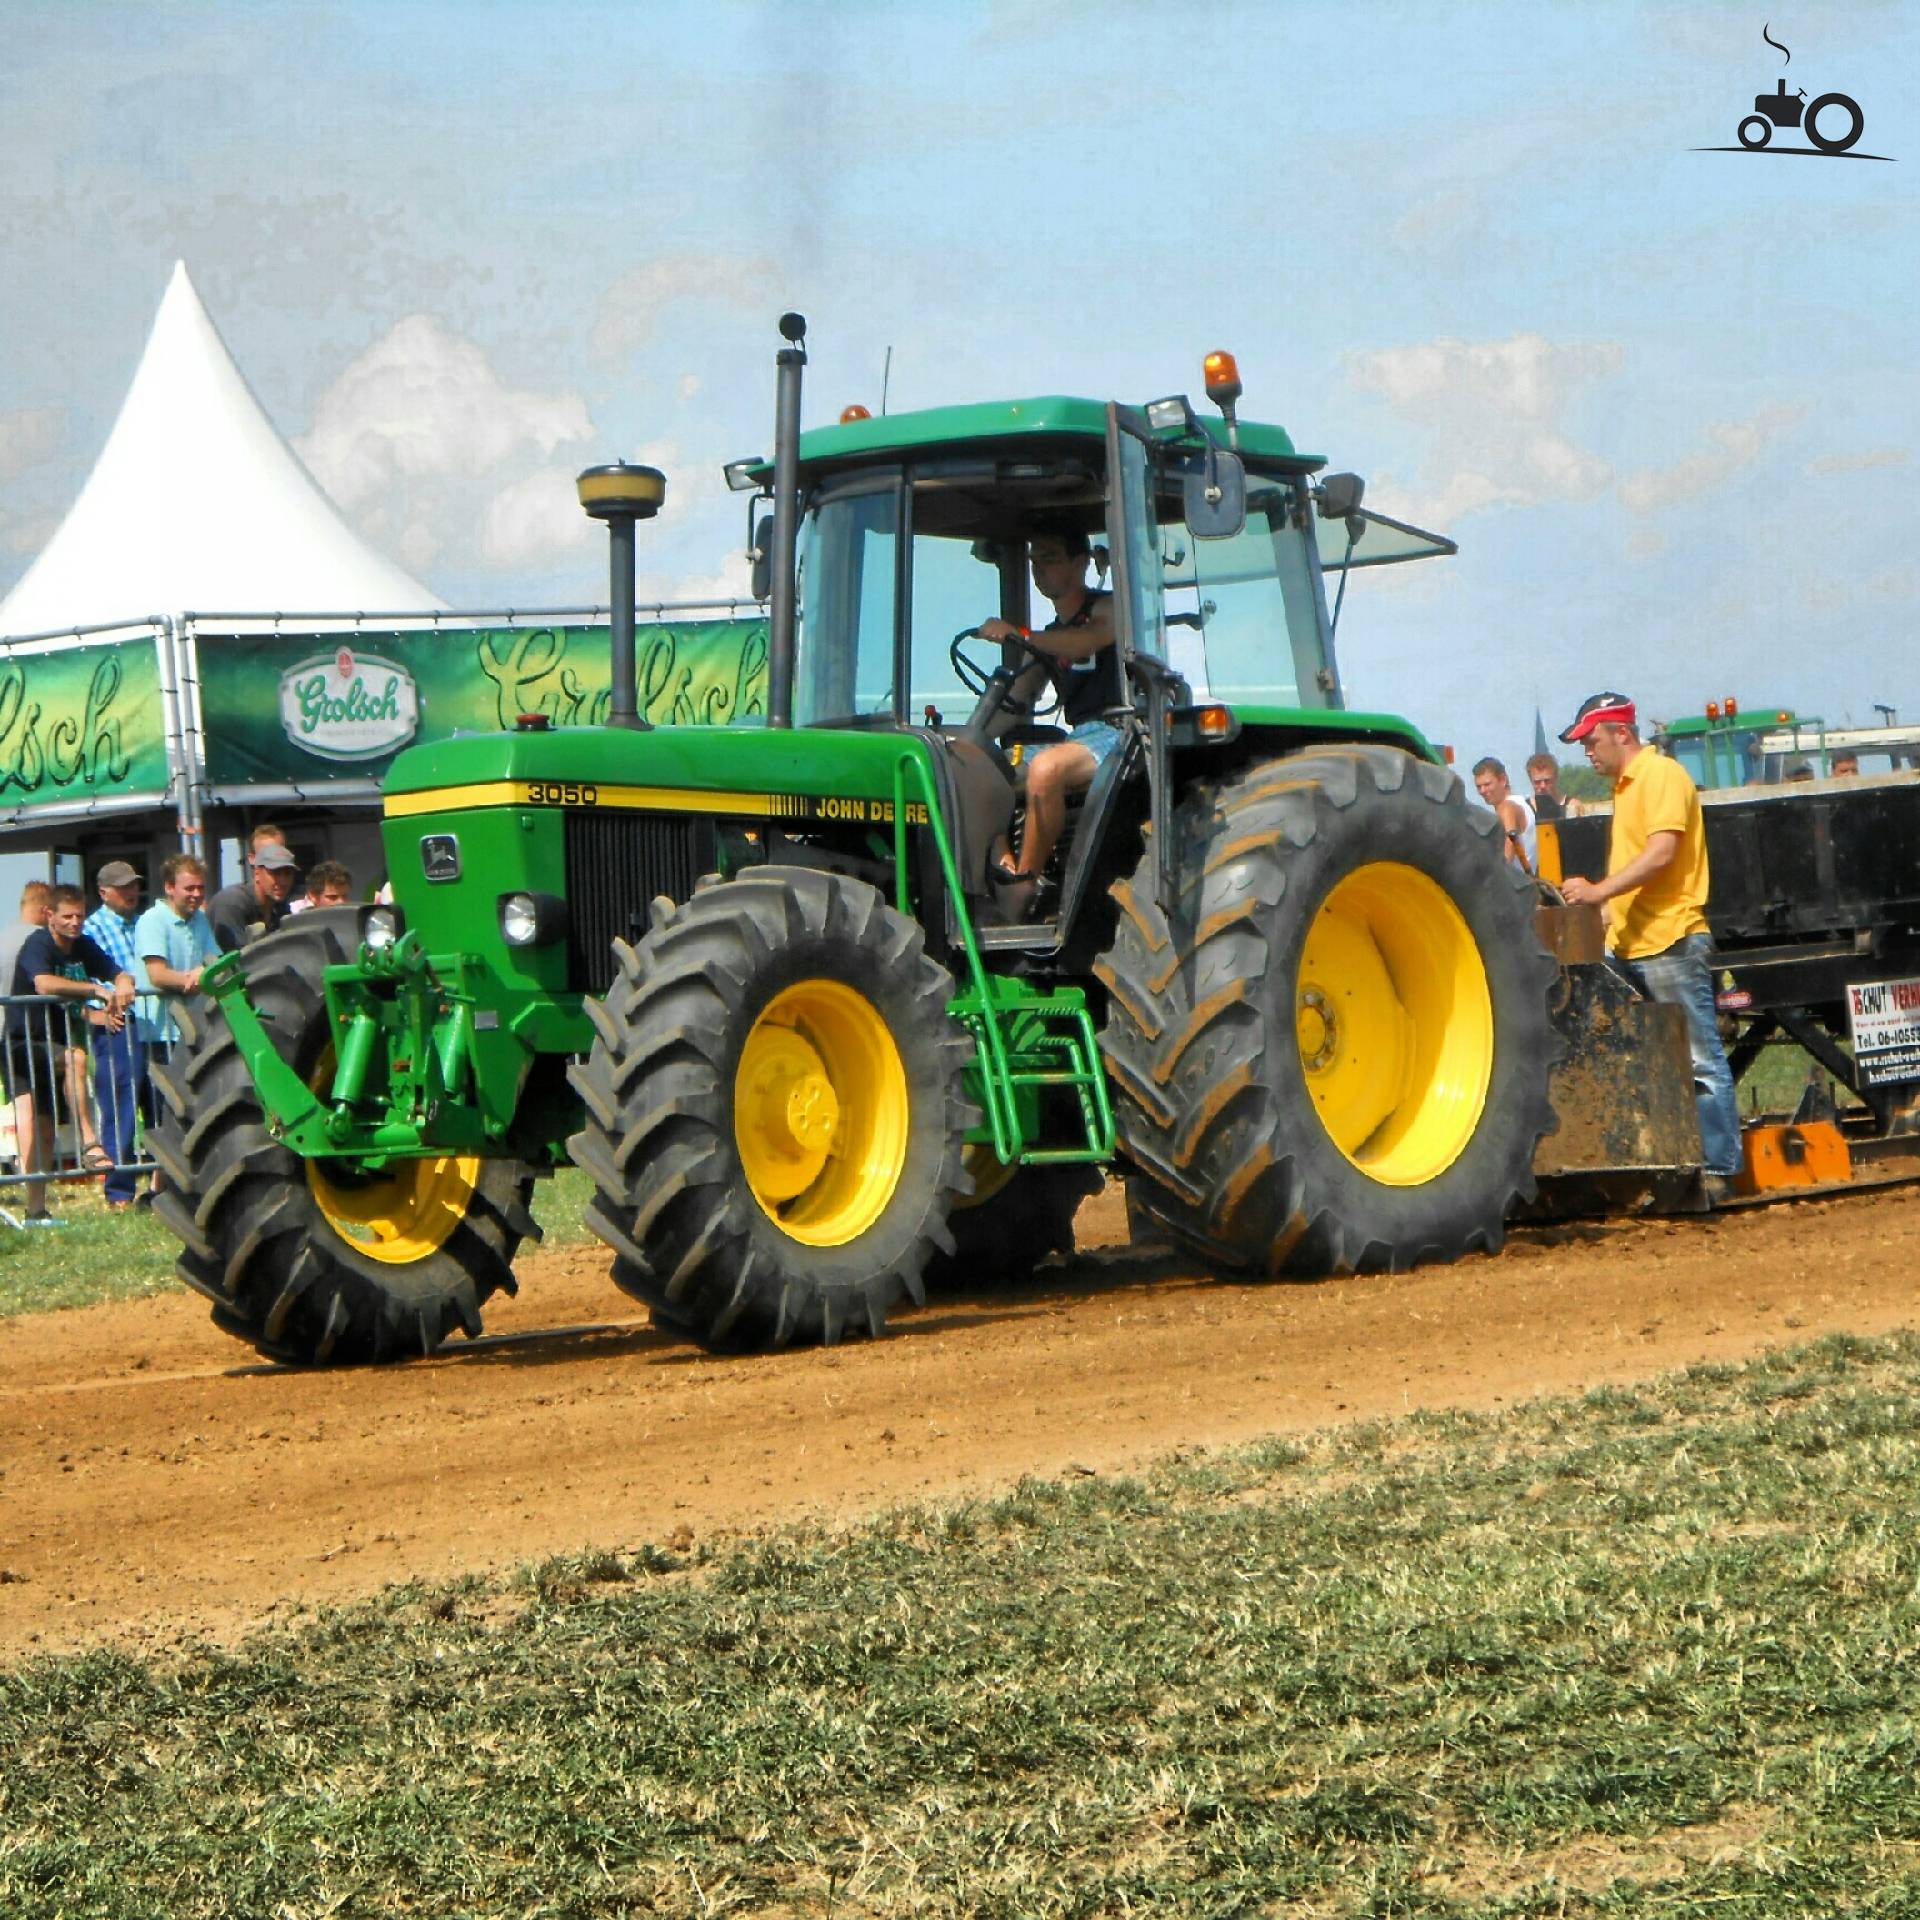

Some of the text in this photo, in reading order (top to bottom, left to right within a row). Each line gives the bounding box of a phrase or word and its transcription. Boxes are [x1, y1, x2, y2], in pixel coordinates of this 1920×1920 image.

[294, 674, 399, 734] Grolsch
[527, 784, 597, 805] 3050
[816, 798, 929, 824] JOHN DERE
[1857, 1033, 1875, 1048] Tel.
